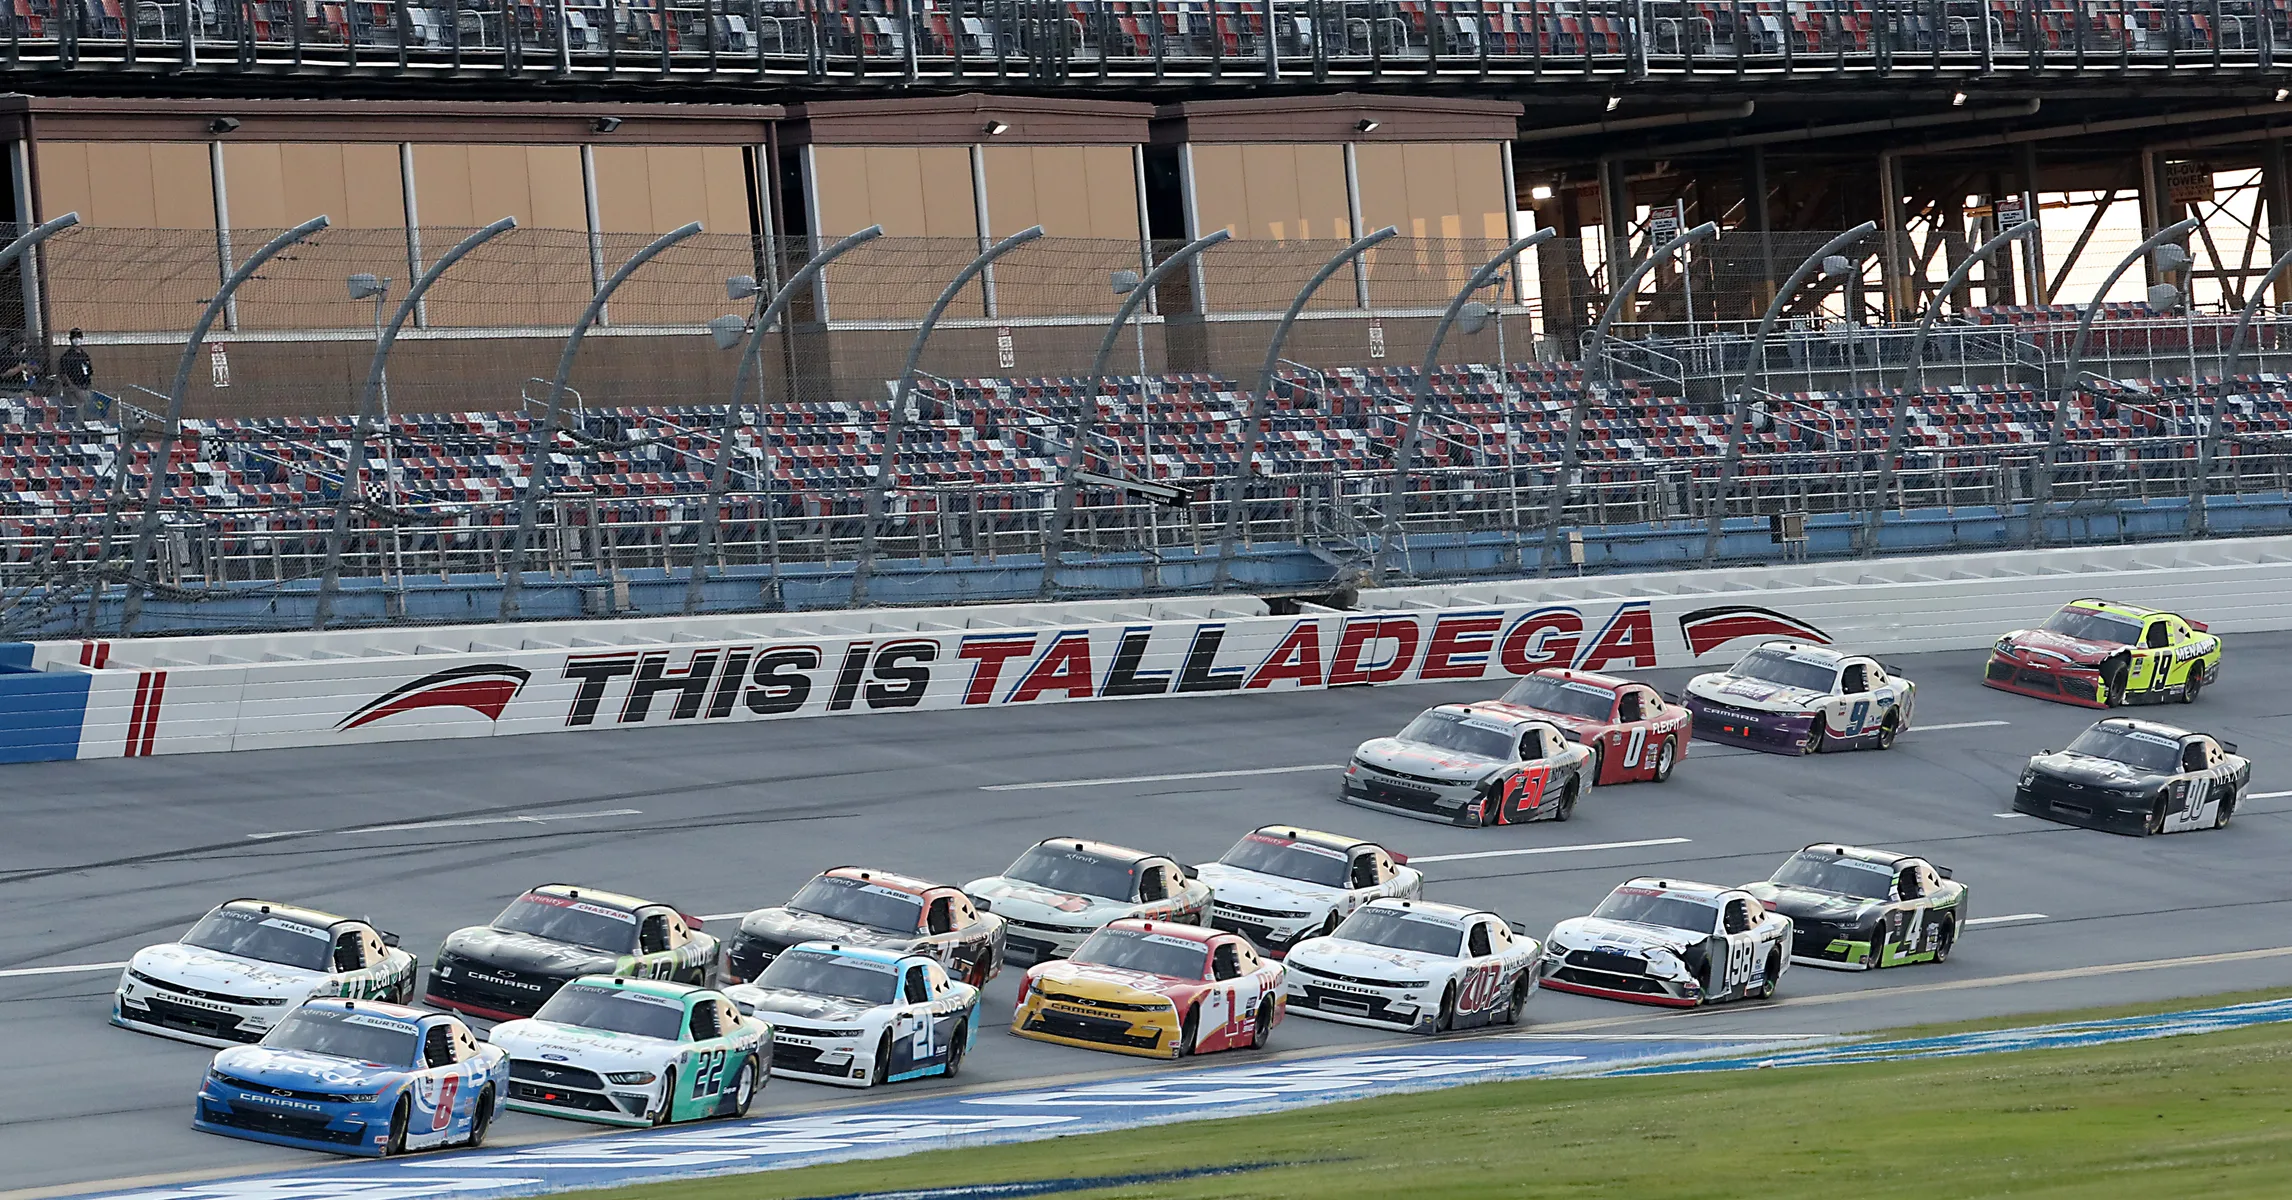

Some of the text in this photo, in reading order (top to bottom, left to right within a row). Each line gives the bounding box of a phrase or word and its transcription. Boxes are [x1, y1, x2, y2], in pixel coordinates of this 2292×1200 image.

[561, 599, 1658, 728] THIS IS TALLADEGA
[2151, 649, 2174, 692] 19
[1568, 682, 1614, 698] EARNHARDT
[1703, 706, 1759, 723] CAMARO
[1845, 699, 1870, 737] 9
[1471, 718, 1509, 733] CLEMENTS
[1516, 763, 1551, 812] 51
[1063, 852, 1099, 865] xfinity
[822, 876, 856, 887] xfinity
[528, 894, 565, 907] xfinity
[217, 909, 257, 923] xfinity
[578, 903, 629, 920] CHASTAIN
[1365, 906, 1400, 918] xfinity
[281, 922, 316, 935] HALEY
[1105, 928, 1140, 938] xfinity
[1904, 902, 1925, 954] 4
[1158, 935, 1198, 948] ANNETT
[790, 950, 827, 962] xfinity
[1730, 936, 1754, 987] 98
[467, 969, 542, 993] CAMARO
[1312, 979, 1381, 995] CAMARO
[573, 985, 609, 995] xfinity
[154, 991, 233, 1012] CAMARO
[633, 993, 668, 1005] CINDRIC
[299, 1007, 341, 1020] xfinity
[1050, 1001, 1122, 1020] CAMARO
[355, 1015, 413, 1031] J. BURTON
[911, 1006, 936, 1061] 21
[540, 1043, 581, 1054] PENNZOIL
[691, 1046, 727, 1100] 22
[239, 1092, 322, 1113] CAMARO
[431, 1072, 460, 1132] 8
